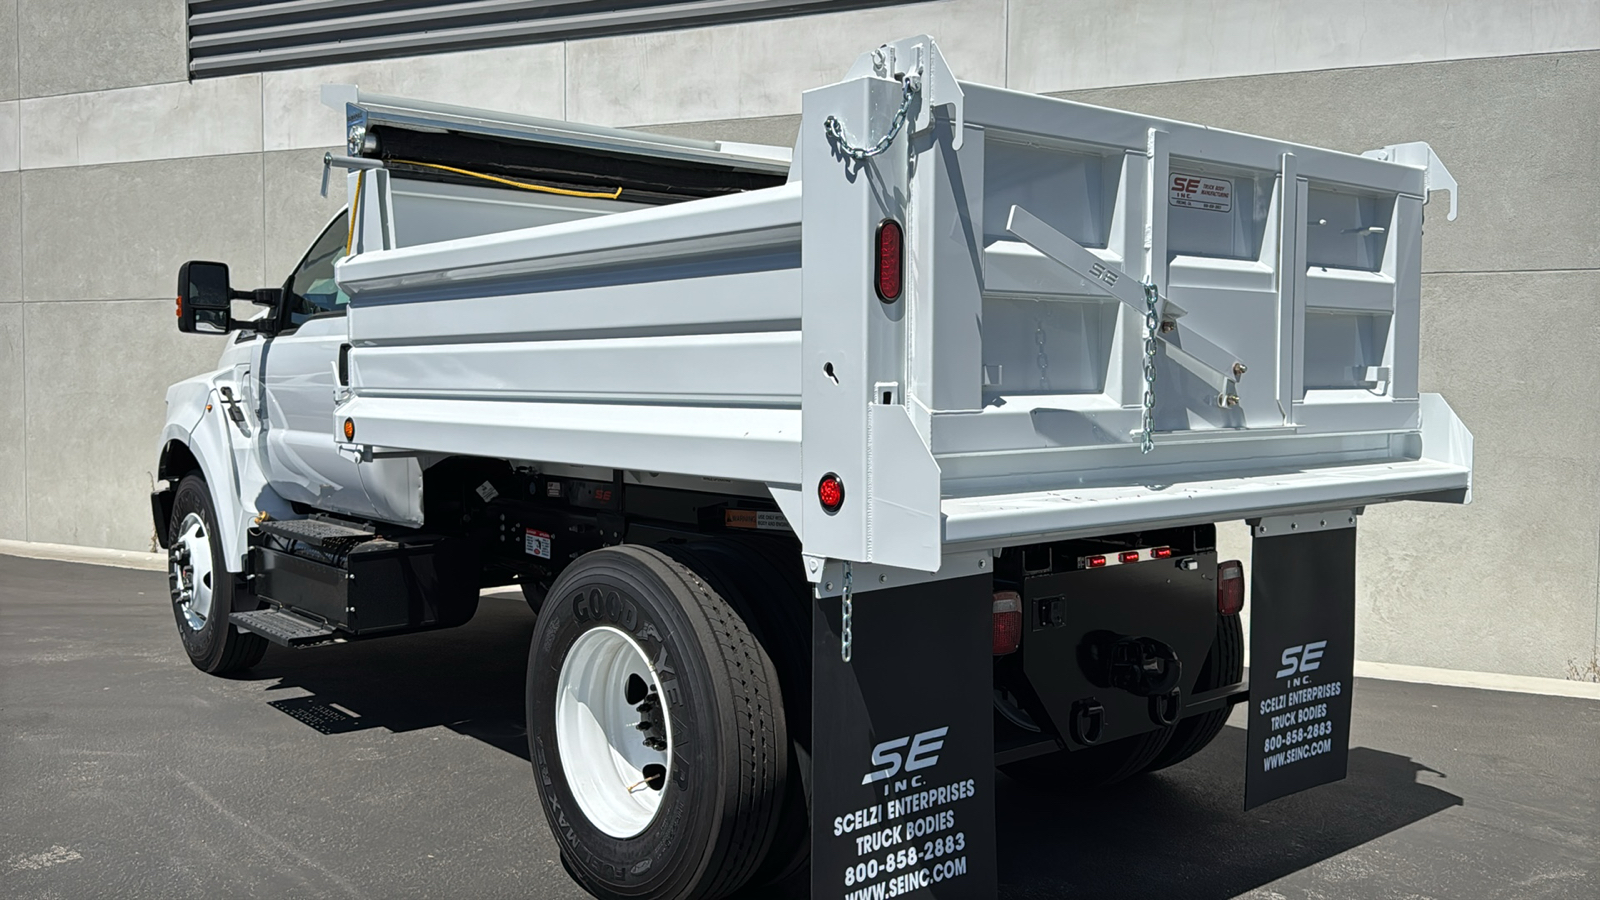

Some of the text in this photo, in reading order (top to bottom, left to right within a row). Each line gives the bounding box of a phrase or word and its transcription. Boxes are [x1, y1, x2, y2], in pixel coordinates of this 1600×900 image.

[1171, 177, 1201, 193] SE
[1089, 262, 1119, 287] SE
[594, 489, 612, 501] SE
[733, 515, 756, 523] WARNING
[1276, 640, 1328, 679] SE
[1260, 681, 1342, 715] SCELZI ENTERPRISES
[1287, 675, 1312, 688] INC.
[1271, 703, 1327, 731] TRUCK BODIES
[1264, 720, 1332, 753] 800-858-2883
[861, 726, 949, 785] SE
[1264, 738, 1332, 772] WWW.SEINC.COM
[884, 775, 926, 796] INC.
[833, 778, 975, 836] SCELZI ENTERPRISES
[856, 809, 955, 856] TRUCK BODIES
[844, 832, 966, 886] 800-858-2883
